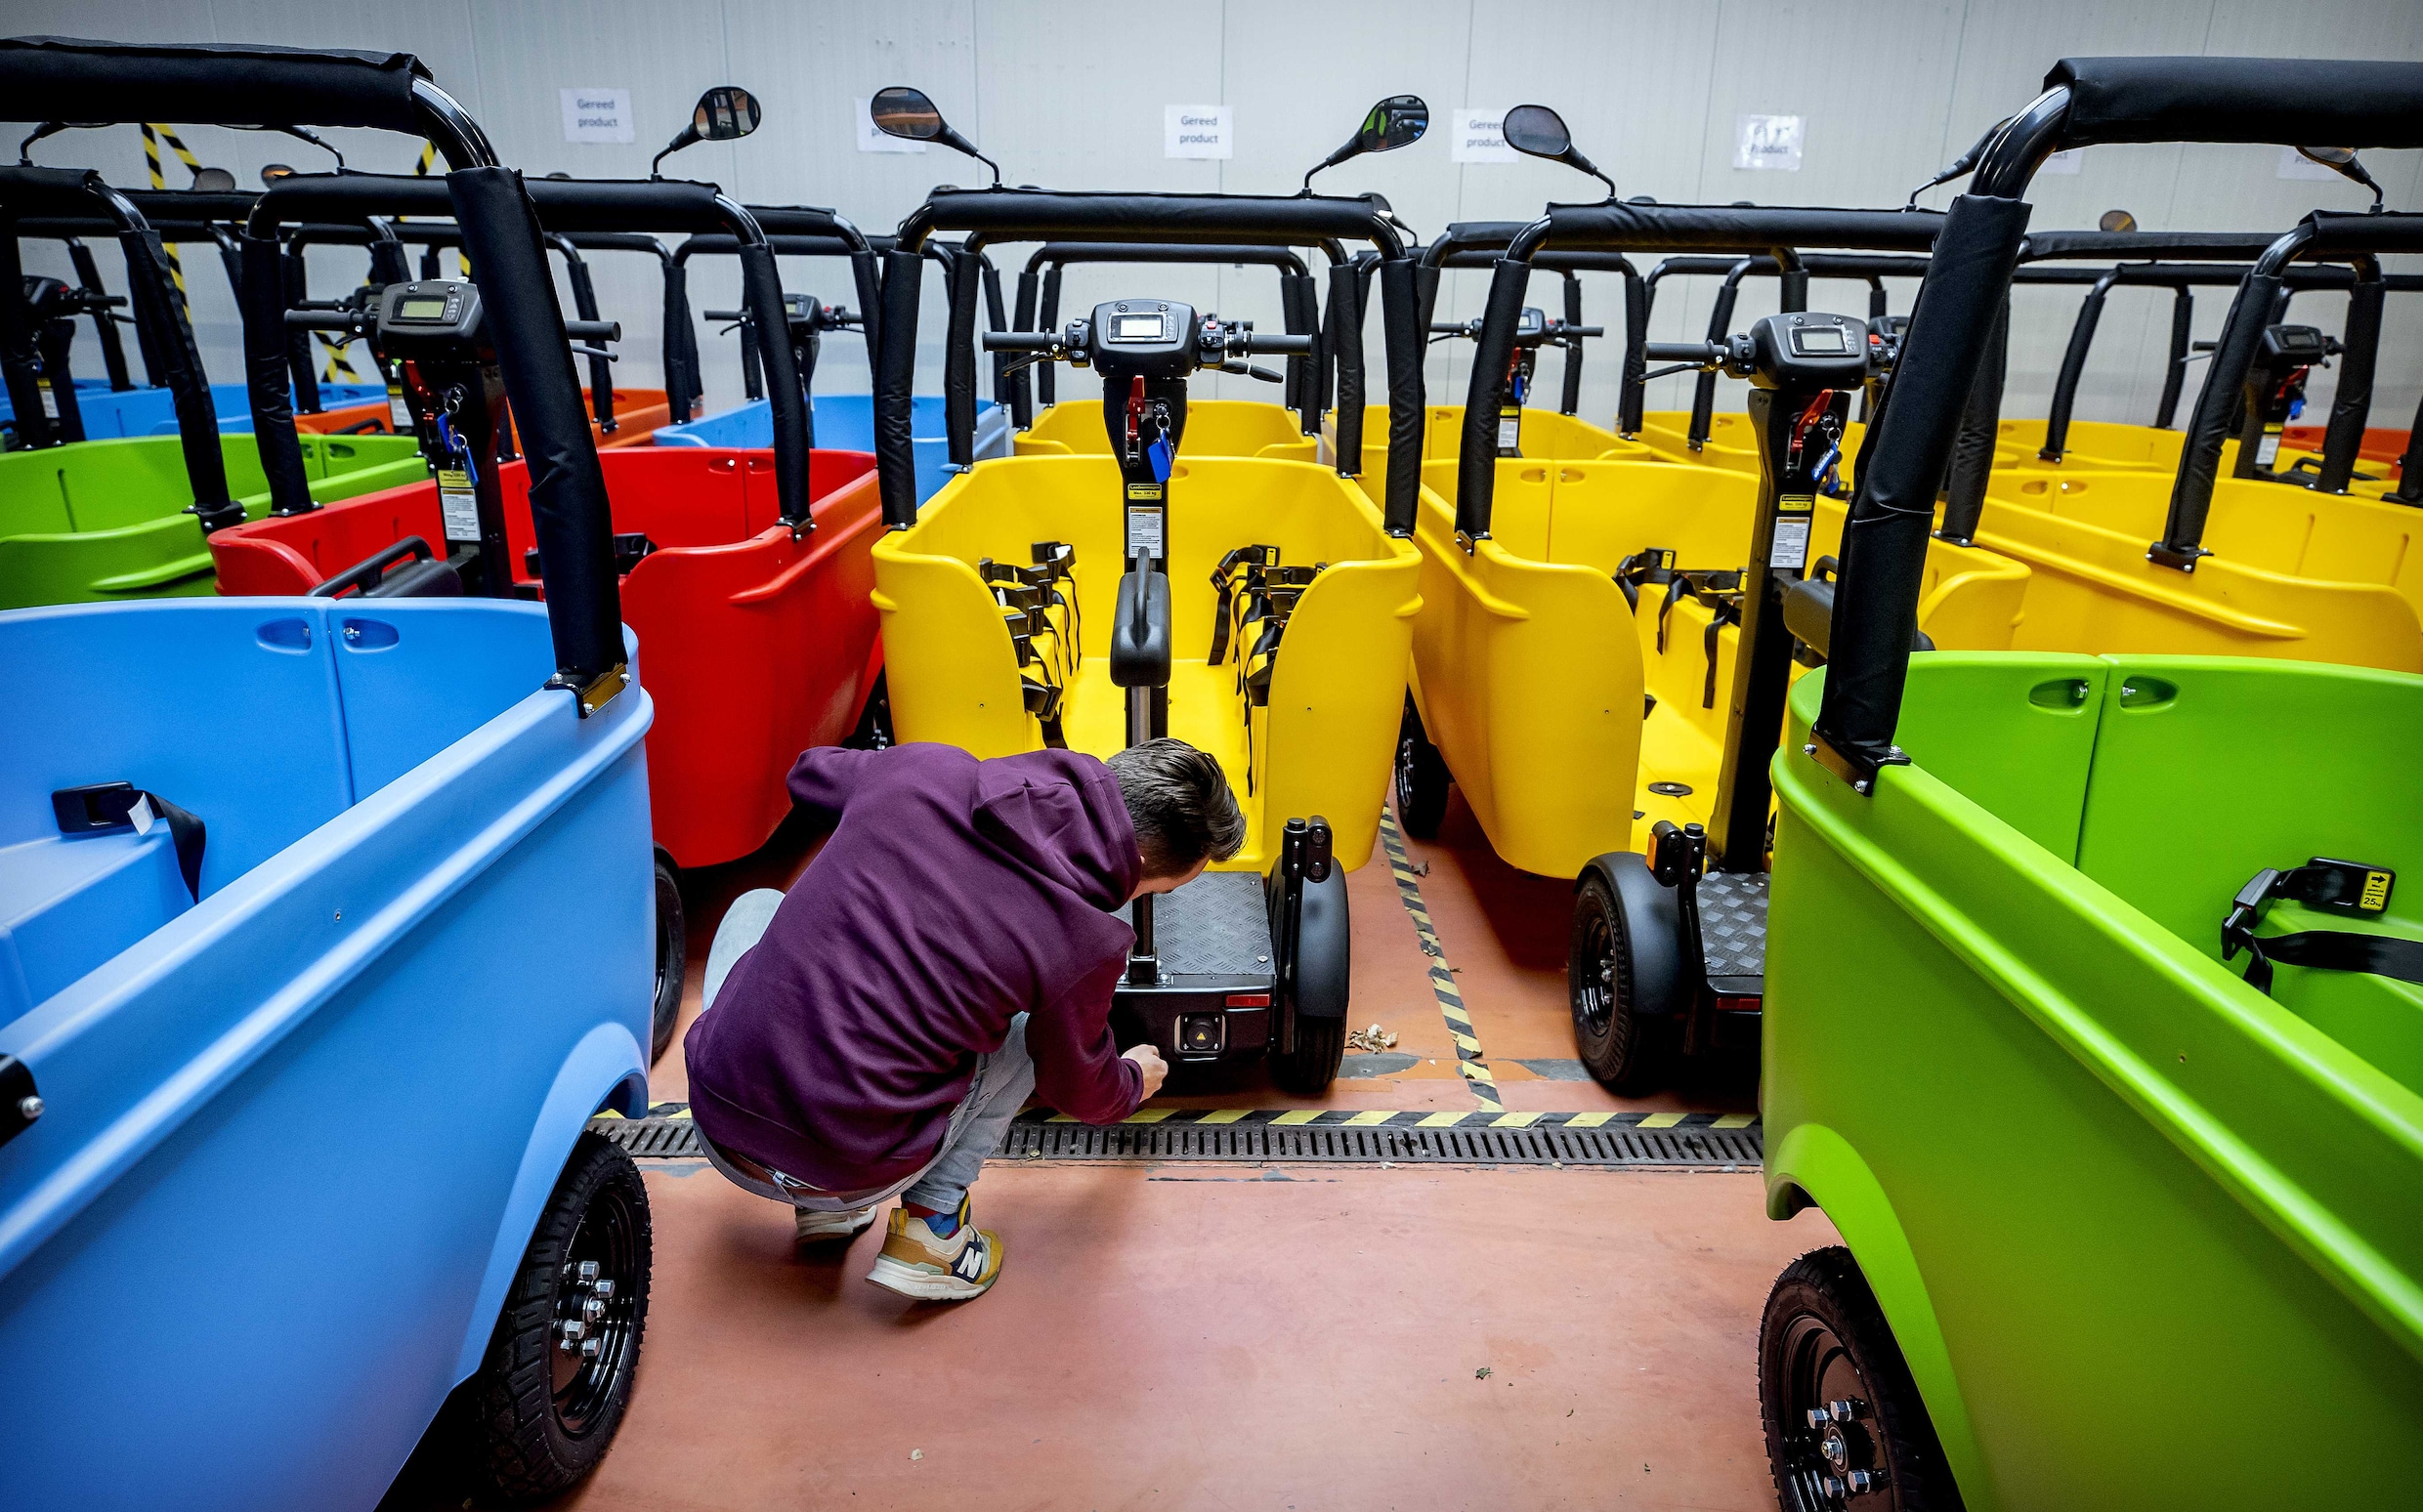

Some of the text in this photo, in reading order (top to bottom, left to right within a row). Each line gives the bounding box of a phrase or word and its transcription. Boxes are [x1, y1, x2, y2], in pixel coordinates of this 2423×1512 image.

[577, 99, 615, 109] Gereed
[578, 116, 617, 129] product
[1180, 115, 1217, 126] Gereed
[1179, 133, 1218, 145] product
[1467, 137, 1506, 148] product
[957, 1247, 983, 1279] N
